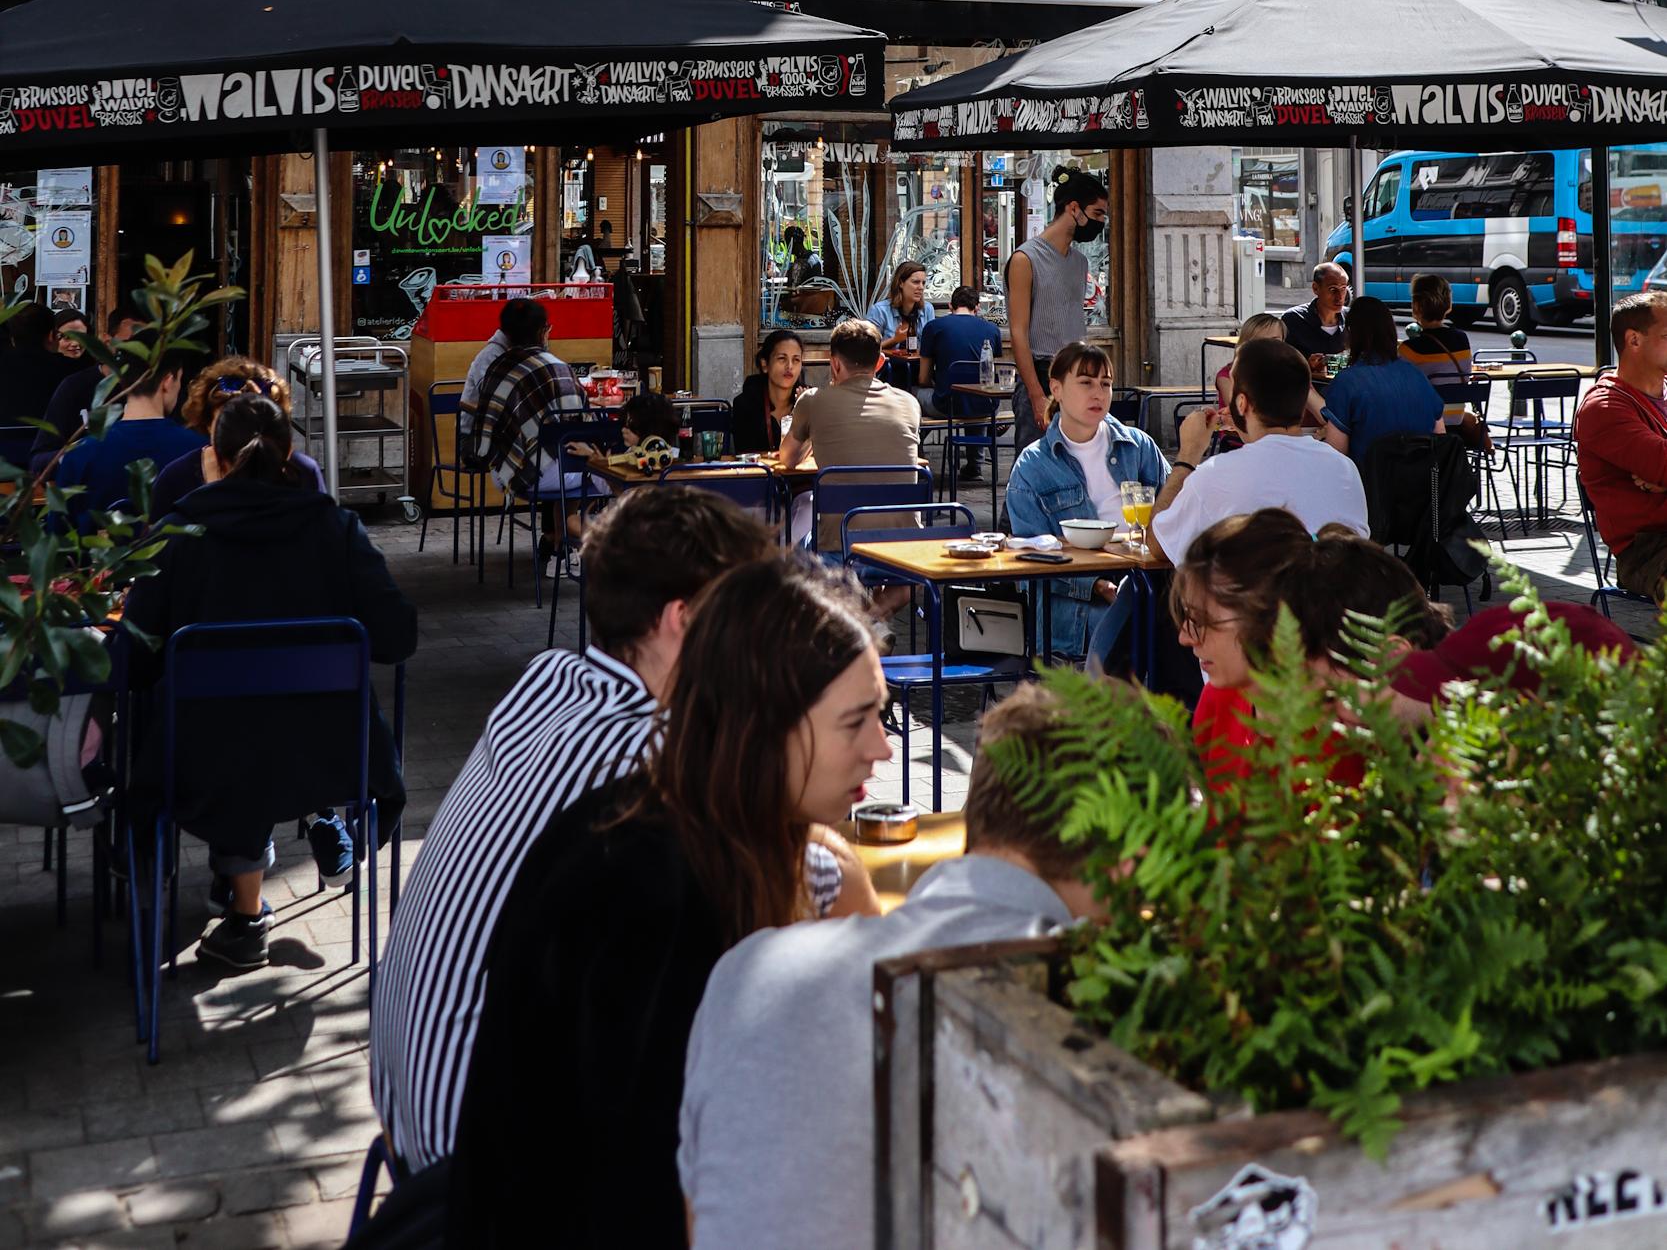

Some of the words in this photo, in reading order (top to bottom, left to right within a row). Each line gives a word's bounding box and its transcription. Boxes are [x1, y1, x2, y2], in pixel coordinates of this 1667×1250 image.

[609, 60, 667, 84] WALVIS
[780, 73, 807, 85] 1000
[446, 64, 577, 109] DANSAERT
[690, 78, 763, 100] DUVEL
[100, 96, 156, 112] WALVIS
[1202, 87, 1252, 109] WALVIS
[1334, 100, 1374, 112] WALVIS
[14, 104, 97, 133] DUVEL
[1272, 104, 1332, 126] DUVEL
